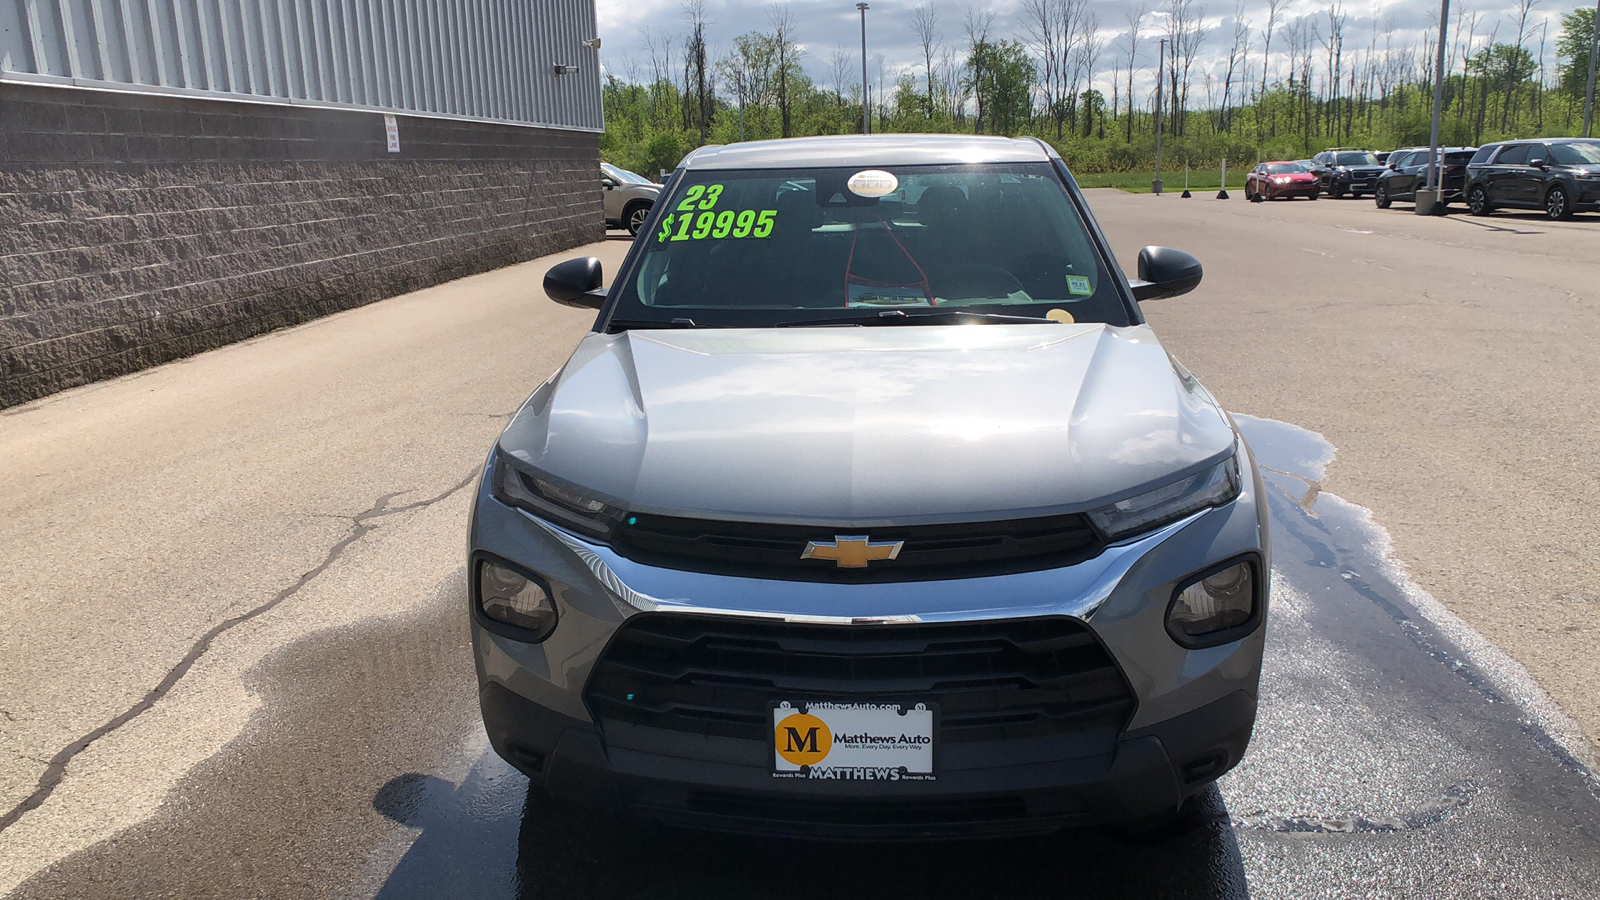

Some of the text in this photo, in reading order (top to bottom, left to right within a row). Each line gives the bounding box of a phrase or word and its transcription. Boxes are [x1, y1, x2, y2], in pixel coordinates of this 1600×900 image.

[677, 184, 724, 211] 23
[658, 210, 778, 243] $19995
[805, 702, 901, 711] MatthewsAuto.com
[783, 726, 821, 752] M
[833, 732, 931, 744] Matthews Auto
[808, 767, 900, 780] MATTHEWS
